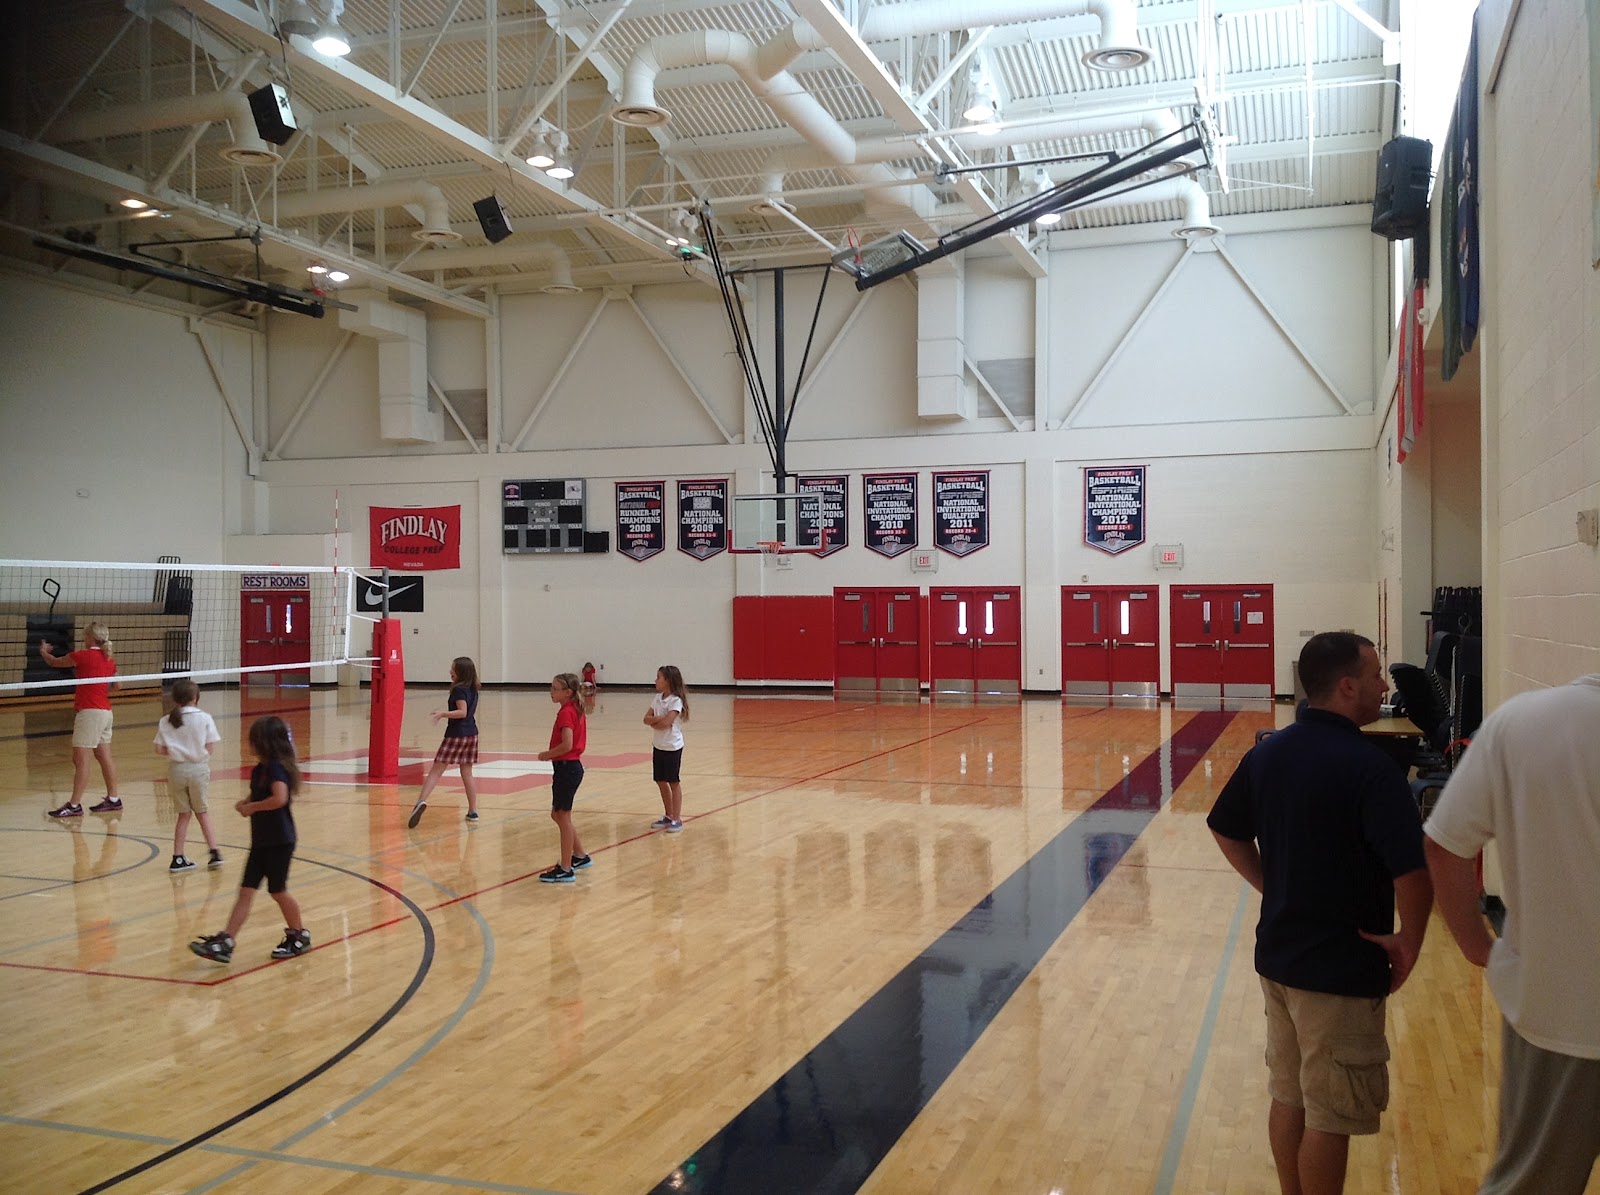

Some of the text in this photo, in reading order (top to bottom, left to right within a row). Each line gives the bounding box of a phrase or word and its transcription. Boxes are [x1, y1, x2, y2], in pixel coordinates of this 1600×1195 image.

[1089, 475, 1140, 487] BASKETBALL
[800, 484, 844, 494] BASKETBALL
[868, 483, 913, 494] BASKETBALL
[937, 481, 985, 492] BASKETBALL
[620, 491, 660, 501] BASKETBALL
[681, 489, 723, 499] BASKETBALL
[1101, 516, 1128, 524] 2012
[381, 516, 447, 546] FINDLAY
[1104, 531, 1125, 540] FINDLAY
[882, 536, 901, 544] FINDLAY
[952, 534, 971, 543] FINDLAY
[244, 577, 305, 586] REST ROOMS
